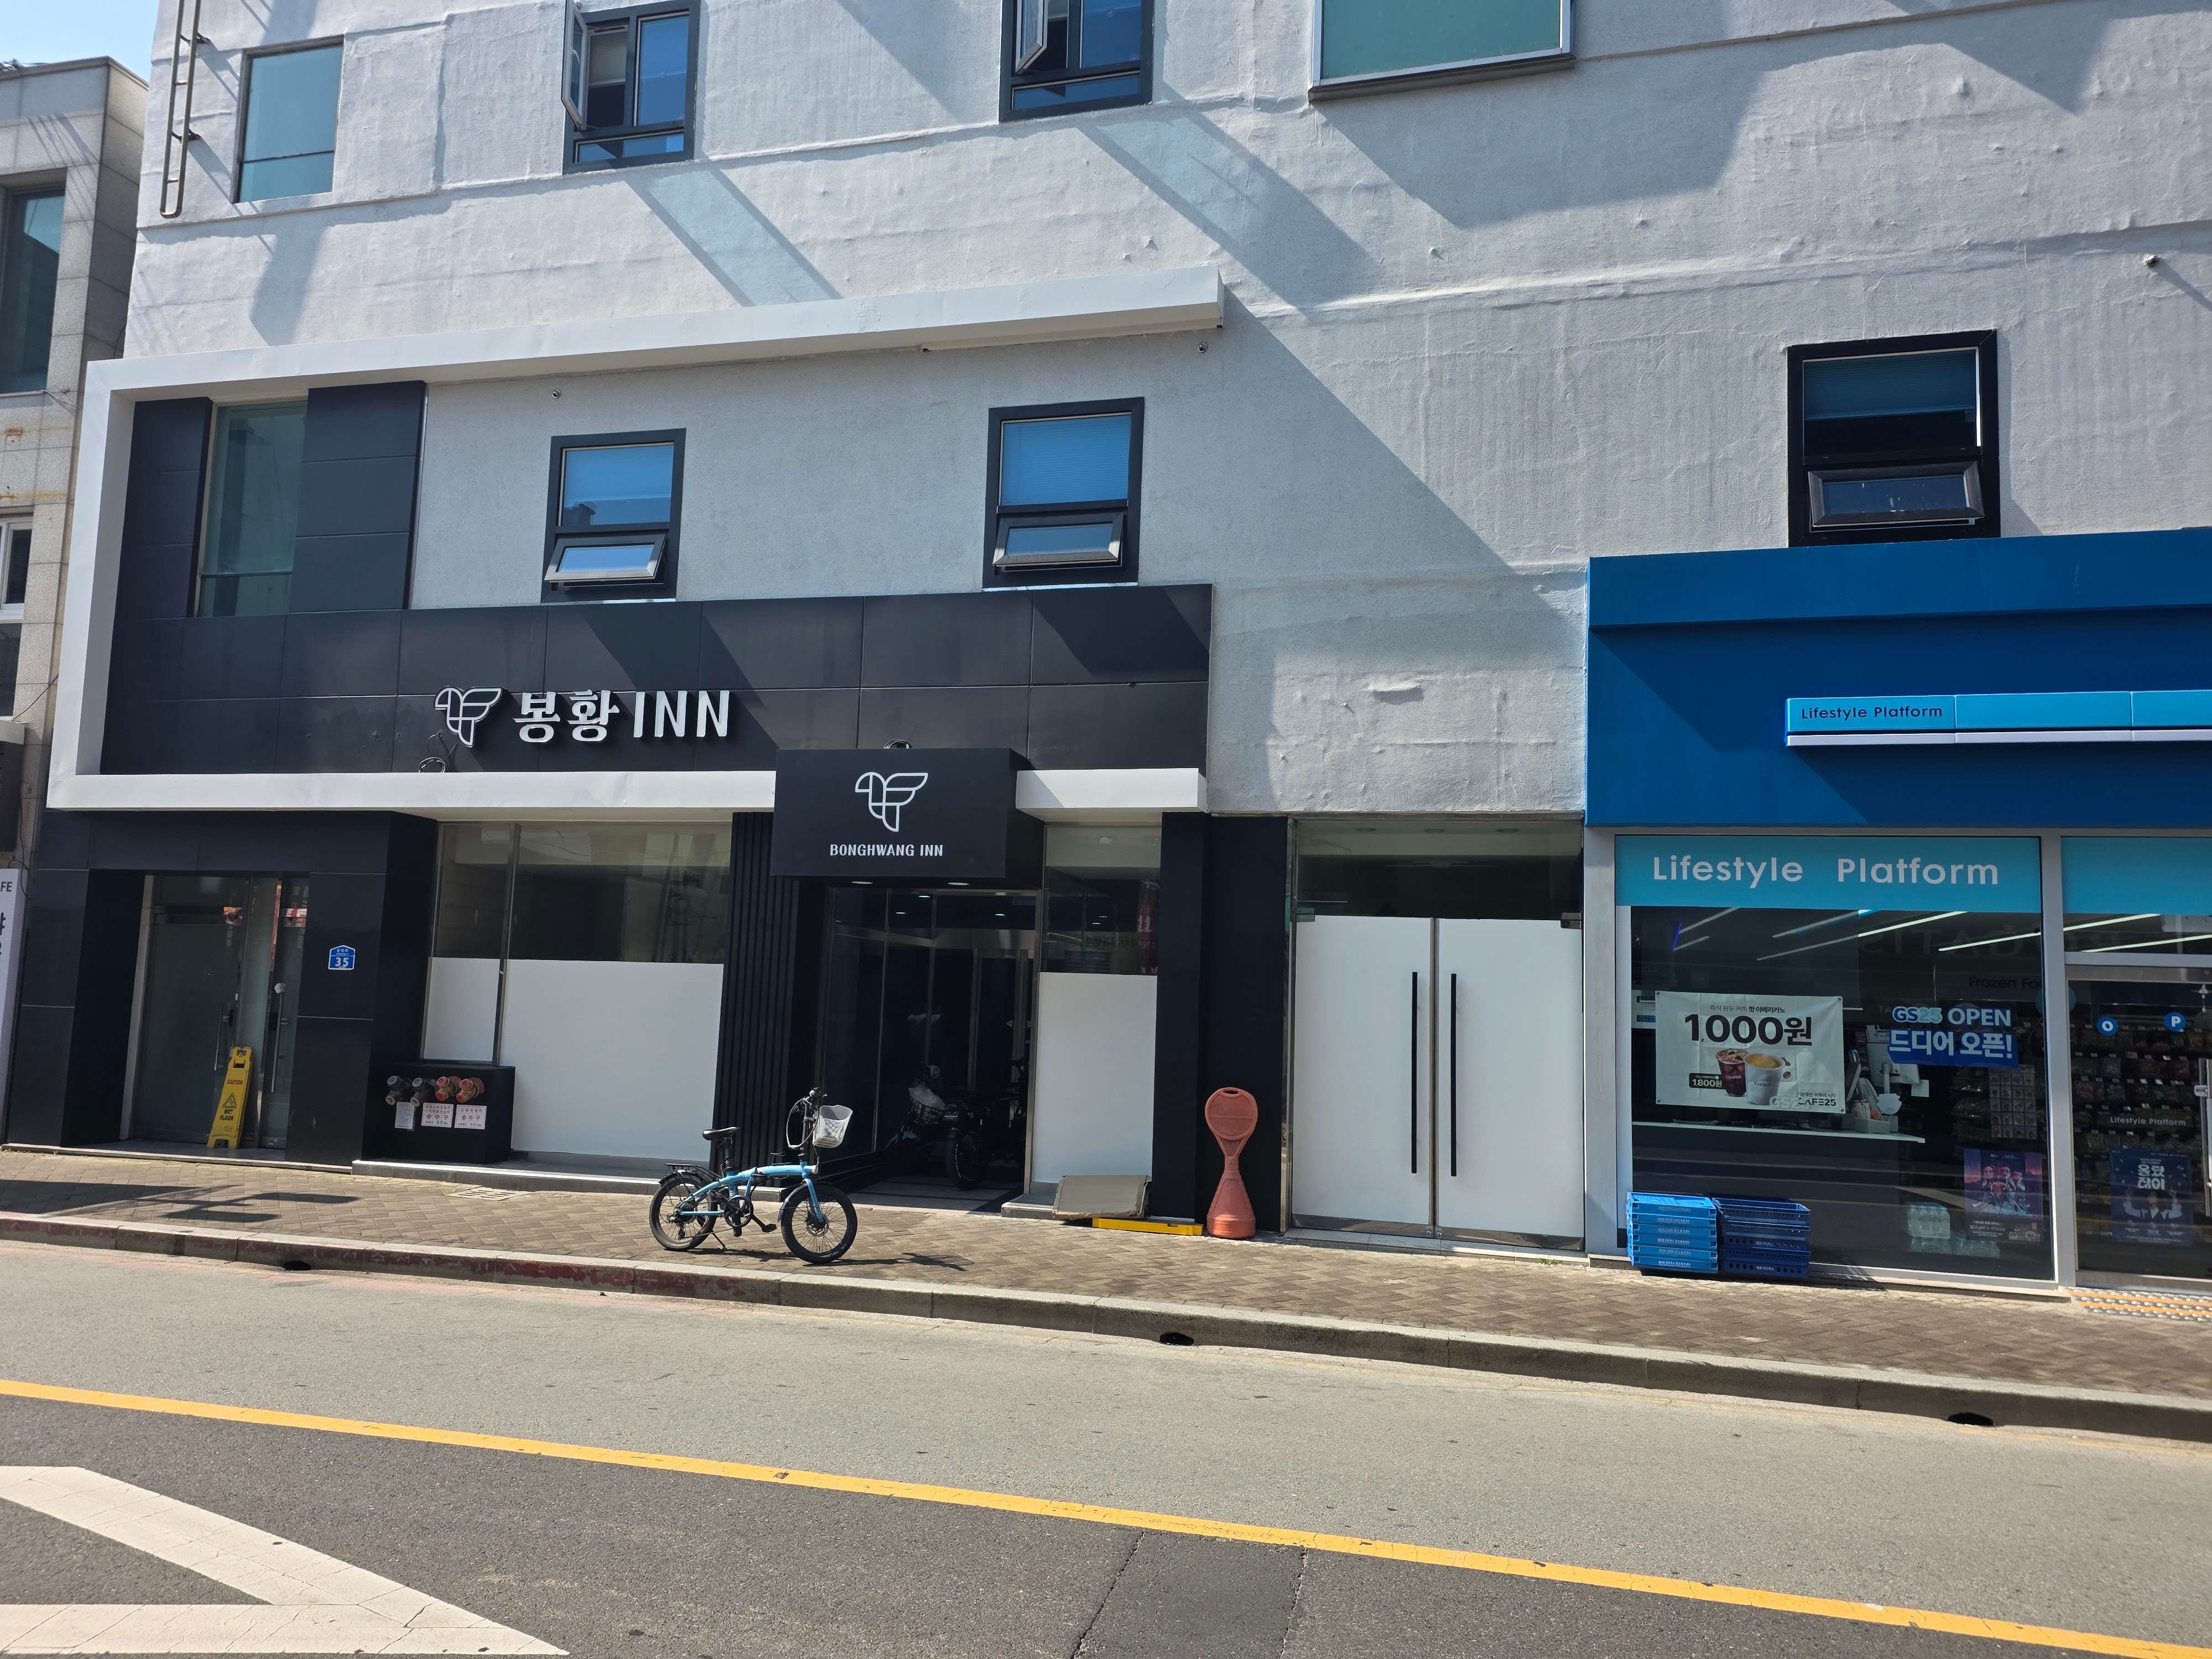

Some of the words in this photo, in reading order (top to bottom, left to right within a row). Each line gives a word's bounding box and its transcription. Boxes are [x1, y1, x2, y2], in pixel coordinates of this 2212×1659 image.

[512, 690, 620, 743] 봉황
[633, 690, 730, 738] INN
[1801, 706, 1867, 721] Lifestyle
[1874, 705, 1942, 719] Platform
[830, 844, 914, 856] BONGHWANG
[920, 844, 943, 856] INN
[1653, 854, 1803, 888] Lifestyle
[1838, 857, 1998, 885] Platform
[335, 957, 348, 967] 35
[1969, 977, 2016, 989] Frozen
[1892, 1006, 1942, 1023] GS25
[1948, 1008, 2011, 1026] OPEN
[1889, 1030, 1954, 1056] 드디어
[1960, 1032, 2012, 1058] 오픈!
[2110, 1117, 2146, 1126] Lifestyle
[2149, 1118, 2186, 1126] Platform
